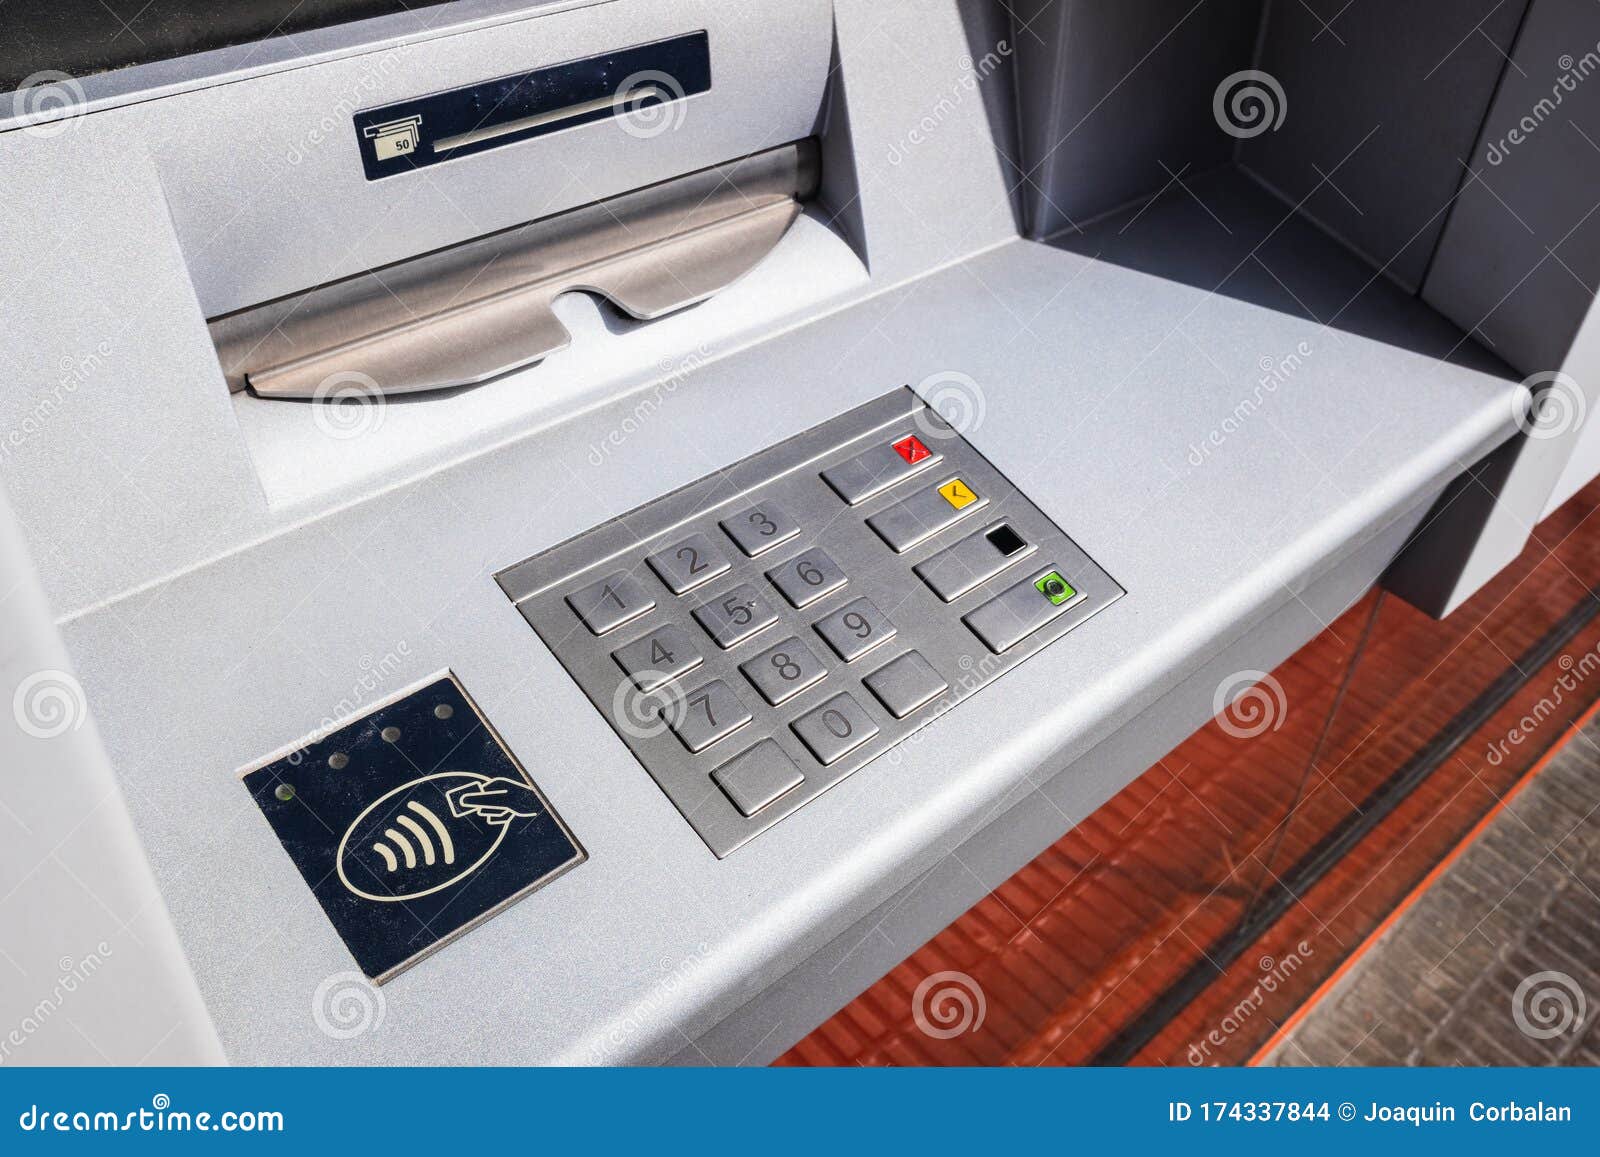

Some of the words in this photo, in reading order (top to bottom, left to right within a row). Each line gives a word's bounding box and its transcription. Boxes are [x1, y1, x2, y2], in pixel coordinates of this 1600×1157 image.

[396, 139, 410, 151] 50
[749, 512, 778, 536] 3
[676, 547, 709, 574] 2
[796, 561, 824, 586] 6
[601, 584, 625, 609] 1
[722, 597, 752, 625] 5
[842, 612, 872, 638] 9
[651, 638, 675, 665] 4
[771, 653, 801, 680] 8
[689, 694, 717, 727] 7
[822, 709, 852, 738] 0
